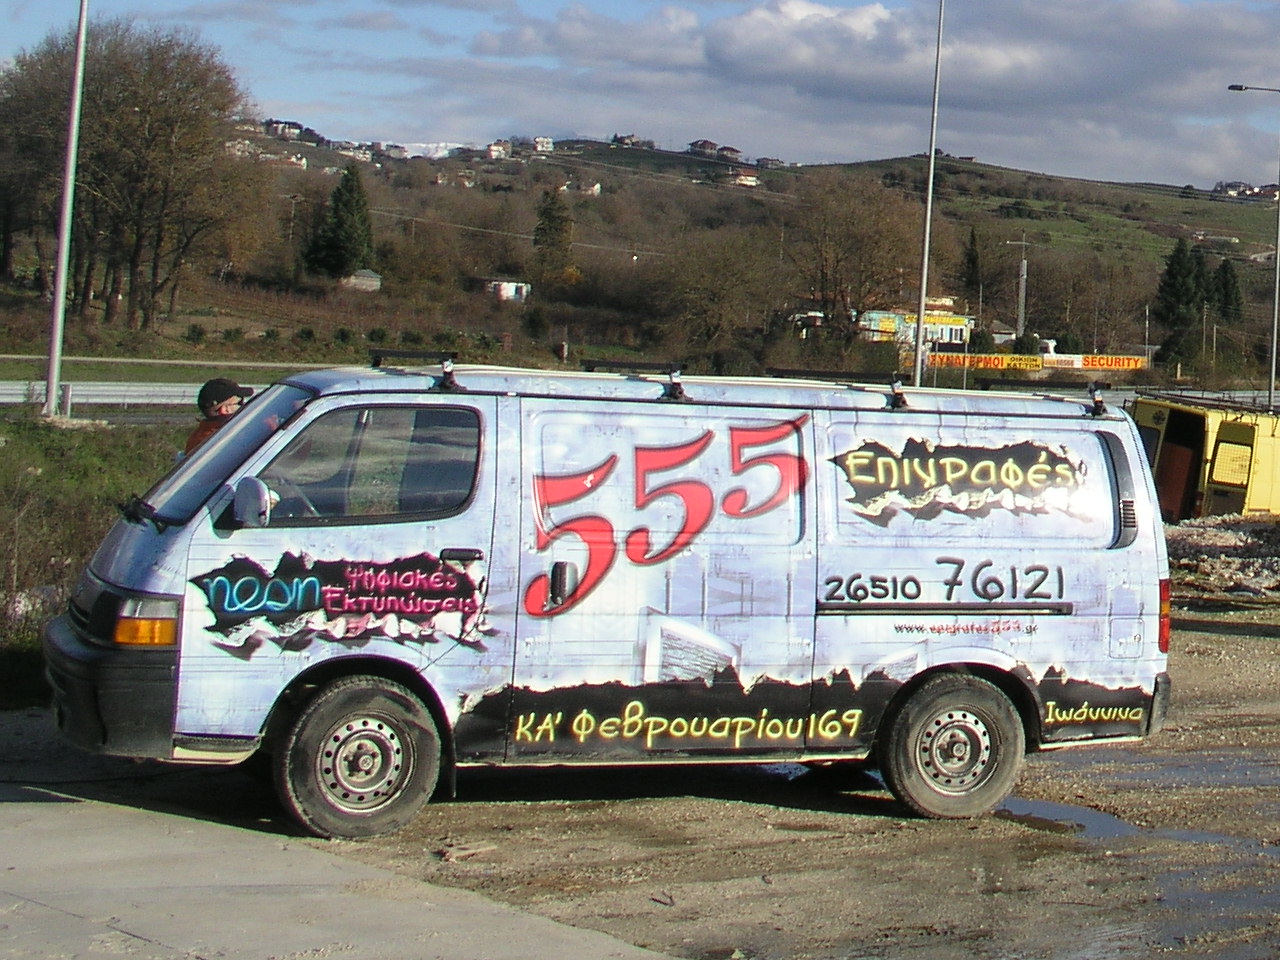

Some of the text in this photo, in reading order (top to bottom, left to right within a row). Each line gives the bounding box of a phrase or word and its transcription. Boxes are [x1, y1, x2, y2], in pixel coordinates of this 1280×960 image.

[1083, 355, 1140, 368] SECURITY
[846, 451, 1075, 489] Επιγραφές
[523, 413, 811, 619] 555
[203, 575, 320, 613] neon
[825, 556, 1065, 602] 26510 76121
[572, 700, 803, 748] Φεβρουαρίου
[808, 709, 863, 739] 169
